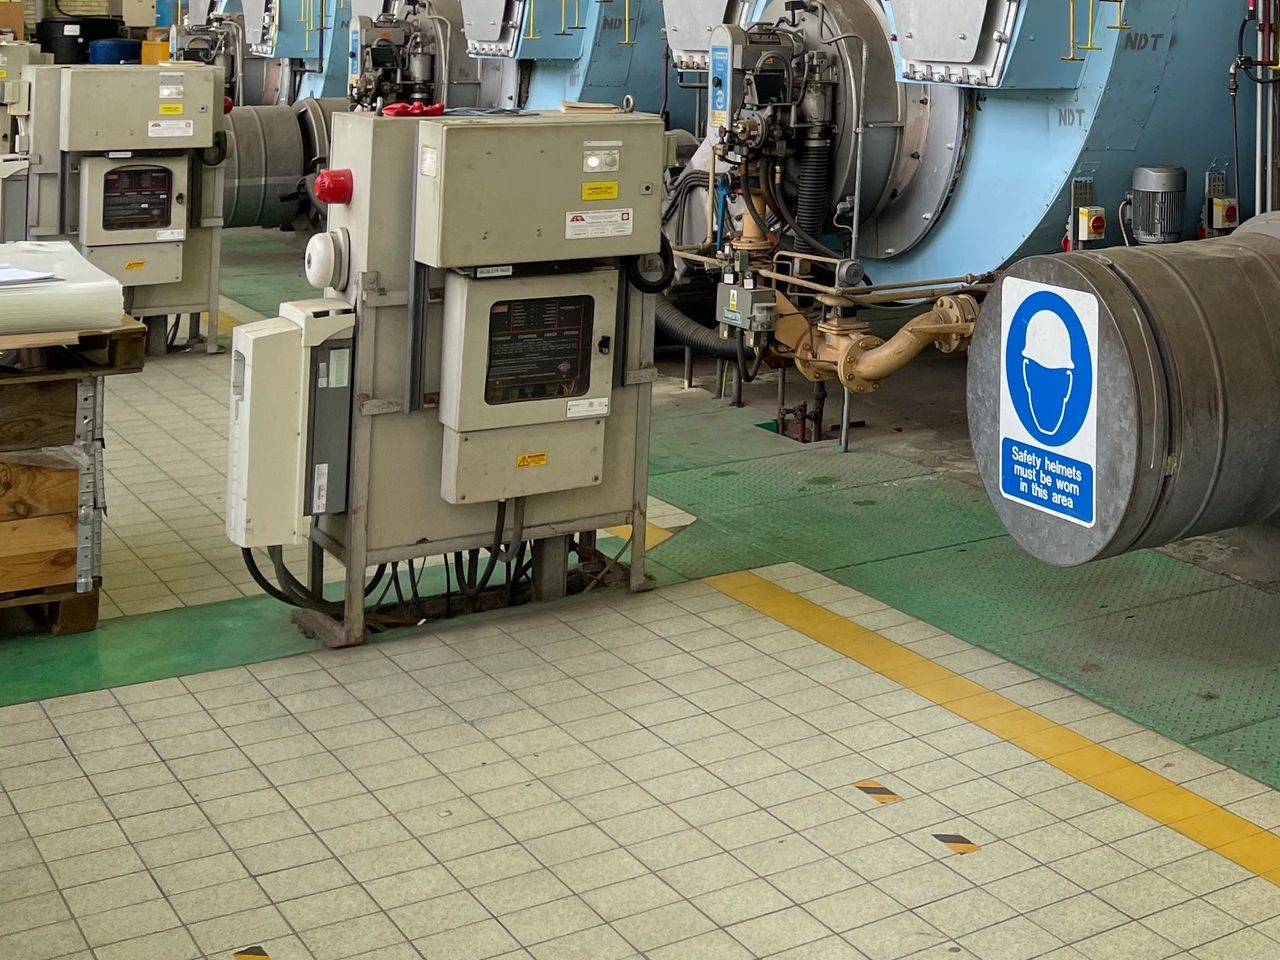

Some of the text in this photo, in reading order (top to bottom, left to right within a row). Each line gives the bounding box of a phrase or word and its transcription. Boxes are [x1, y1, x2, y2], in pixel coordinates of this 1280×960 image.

[1124, 32, 1164, 51] NDT
[1058, 108, 1085, 127] NDT
[1011, 445, 1082, 482] Safety helmets
[1014, 464, 1080, 496] must be worn
[1020, 478, 1074, 509] in this area
